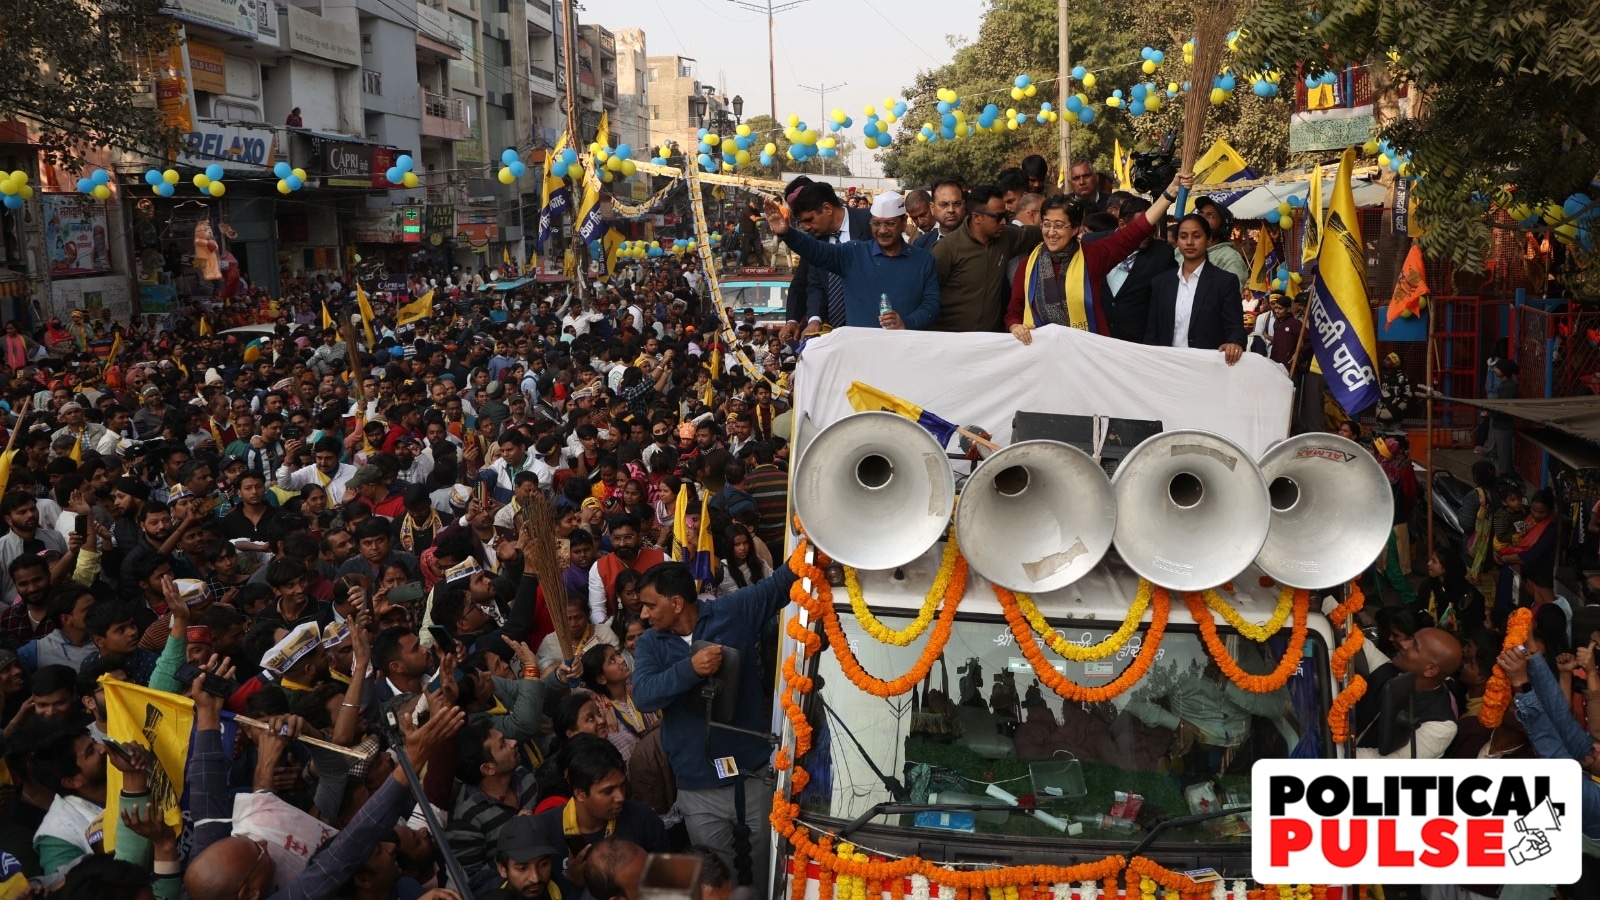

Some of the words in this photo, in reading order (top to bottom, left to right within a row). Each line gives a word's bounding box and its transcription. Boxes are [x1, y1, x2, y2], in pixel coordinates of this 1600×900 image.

[191, 60, 204, 70] OLD
[184, 131, 265, 164] RELAXO
[432, 216, 453, 226] PIZZA
[1333, 343, 1375, 392] पार्टी
